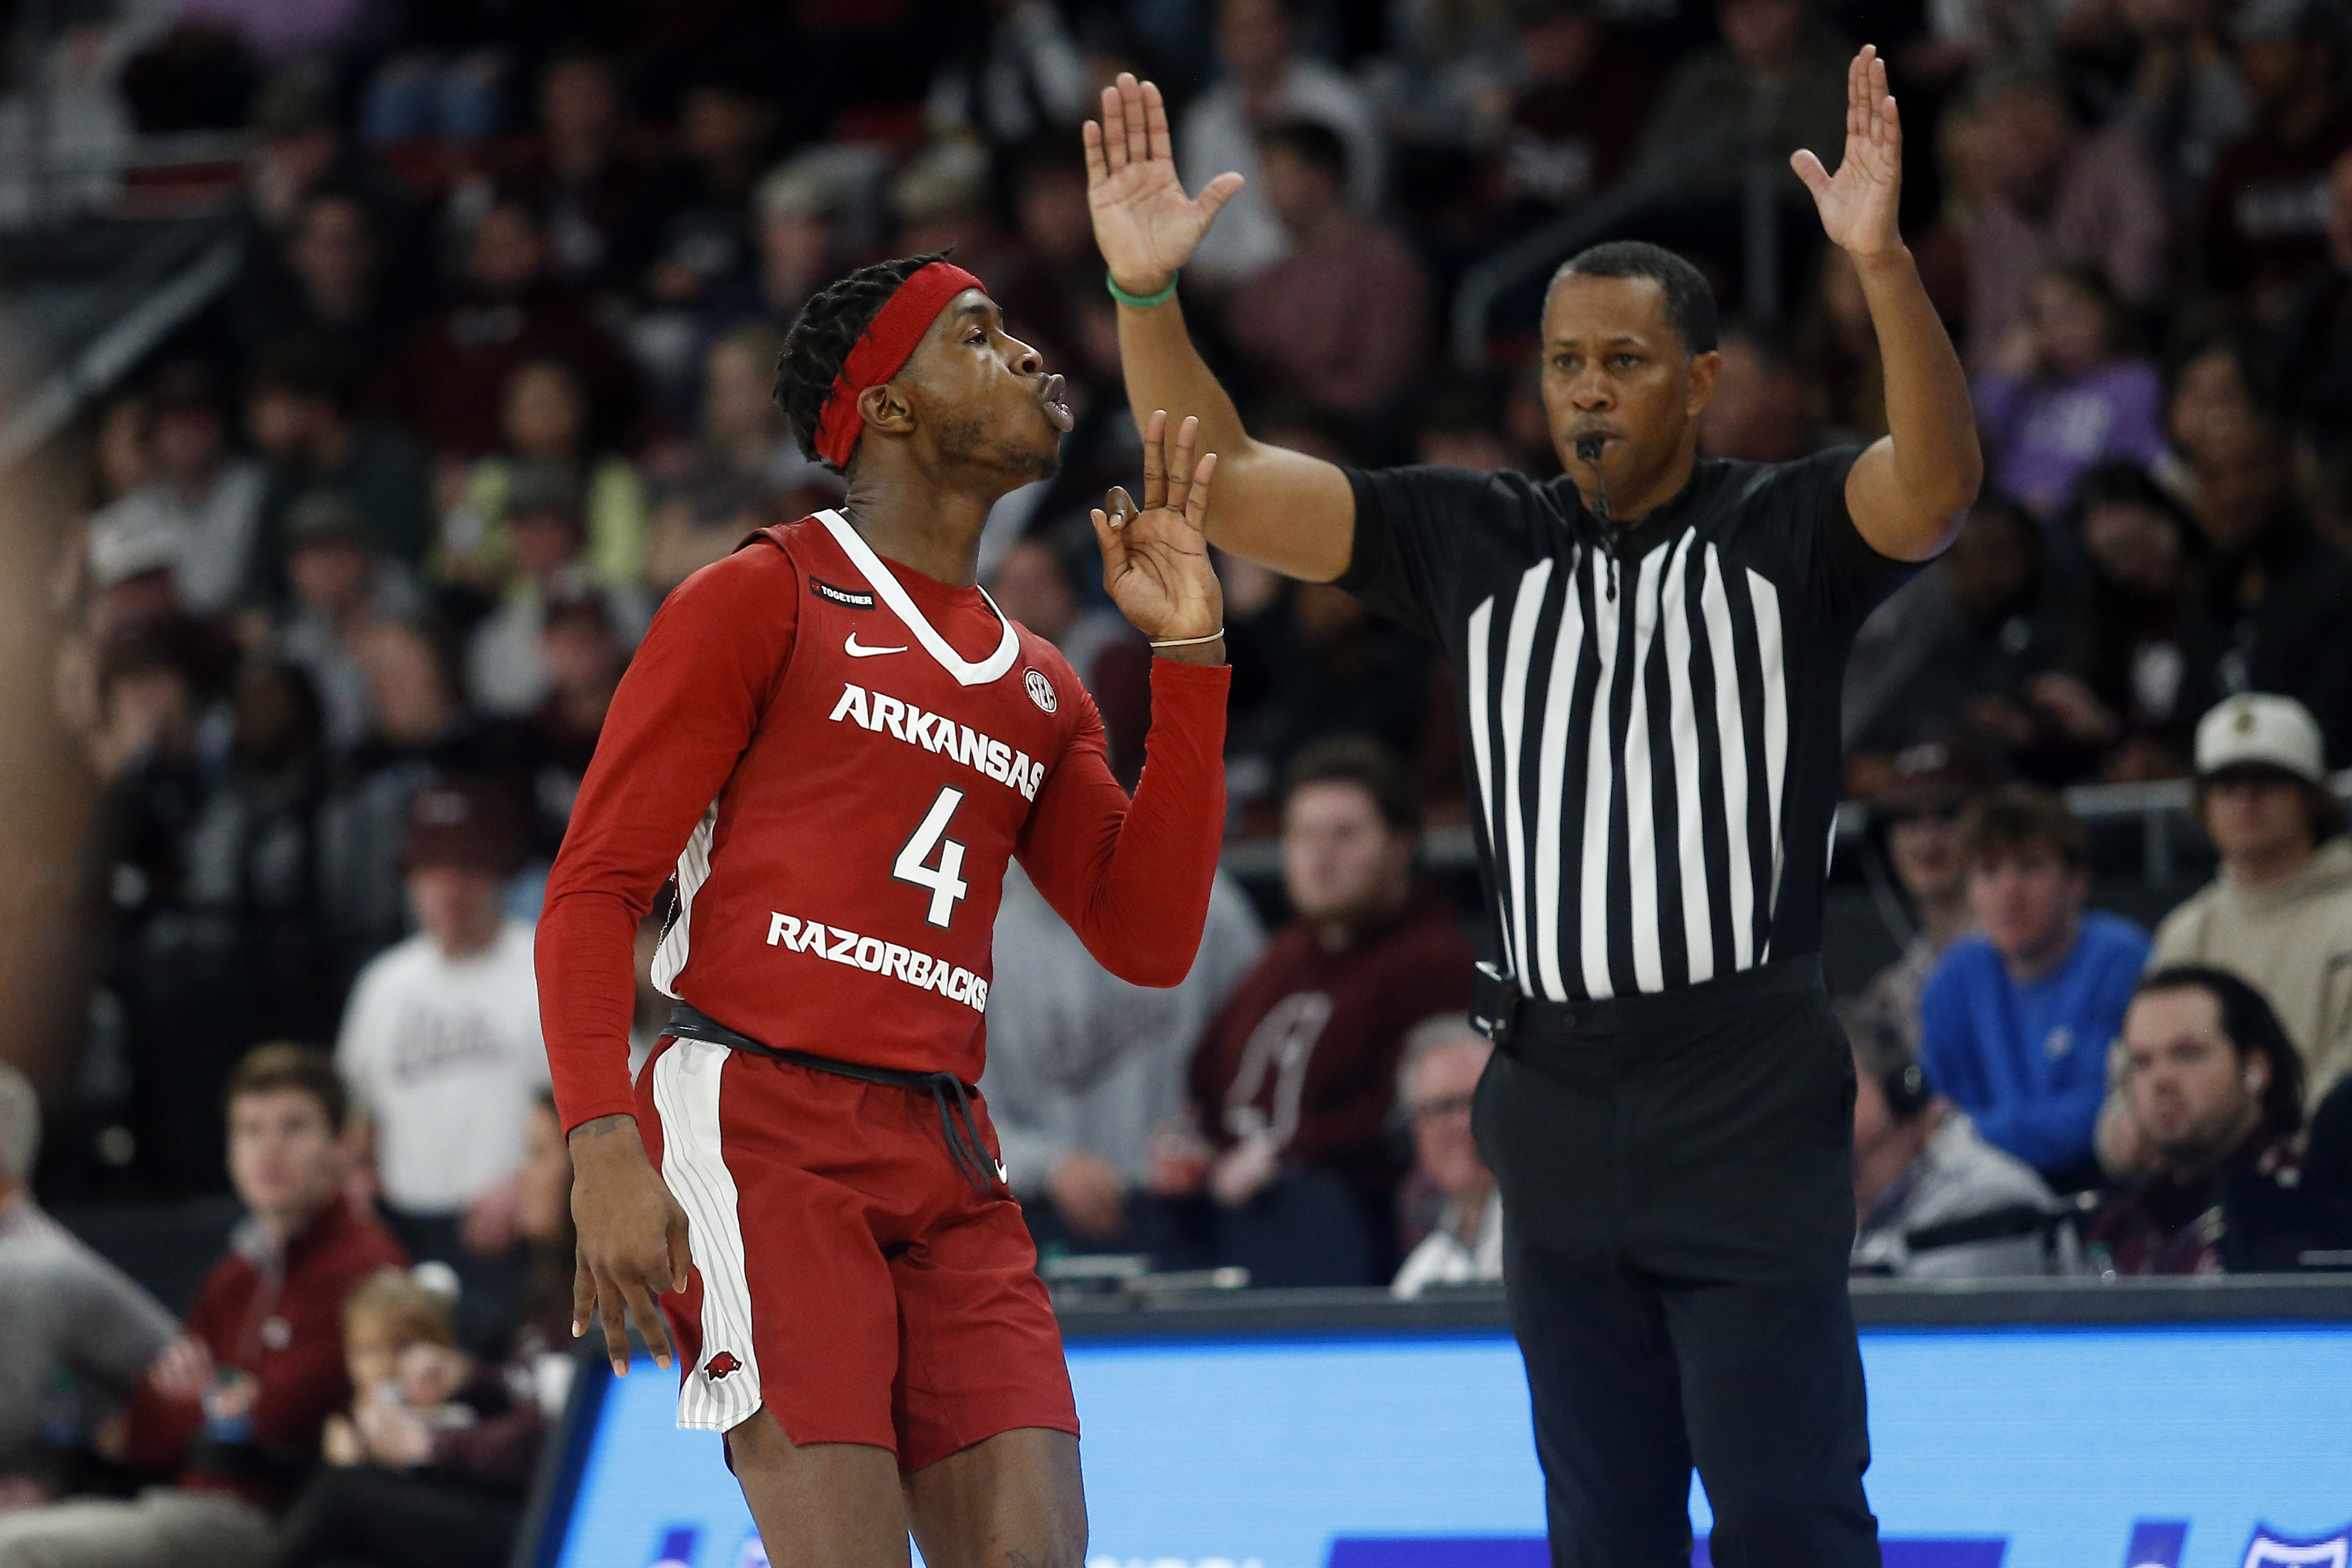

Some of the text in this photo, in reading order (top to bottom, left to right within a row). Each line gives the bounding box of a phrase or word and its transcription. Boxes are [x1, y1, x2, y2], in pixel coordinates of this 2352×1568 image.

[821, 585, 873, 605] TOGETHER
[829, 682, 1045, 802] ARKANSAS
[1028, 673, 1055, 710] SEC
[893, 786, 968, 928] 4
[766, 911, 987, 1014] RAZORBACKS
